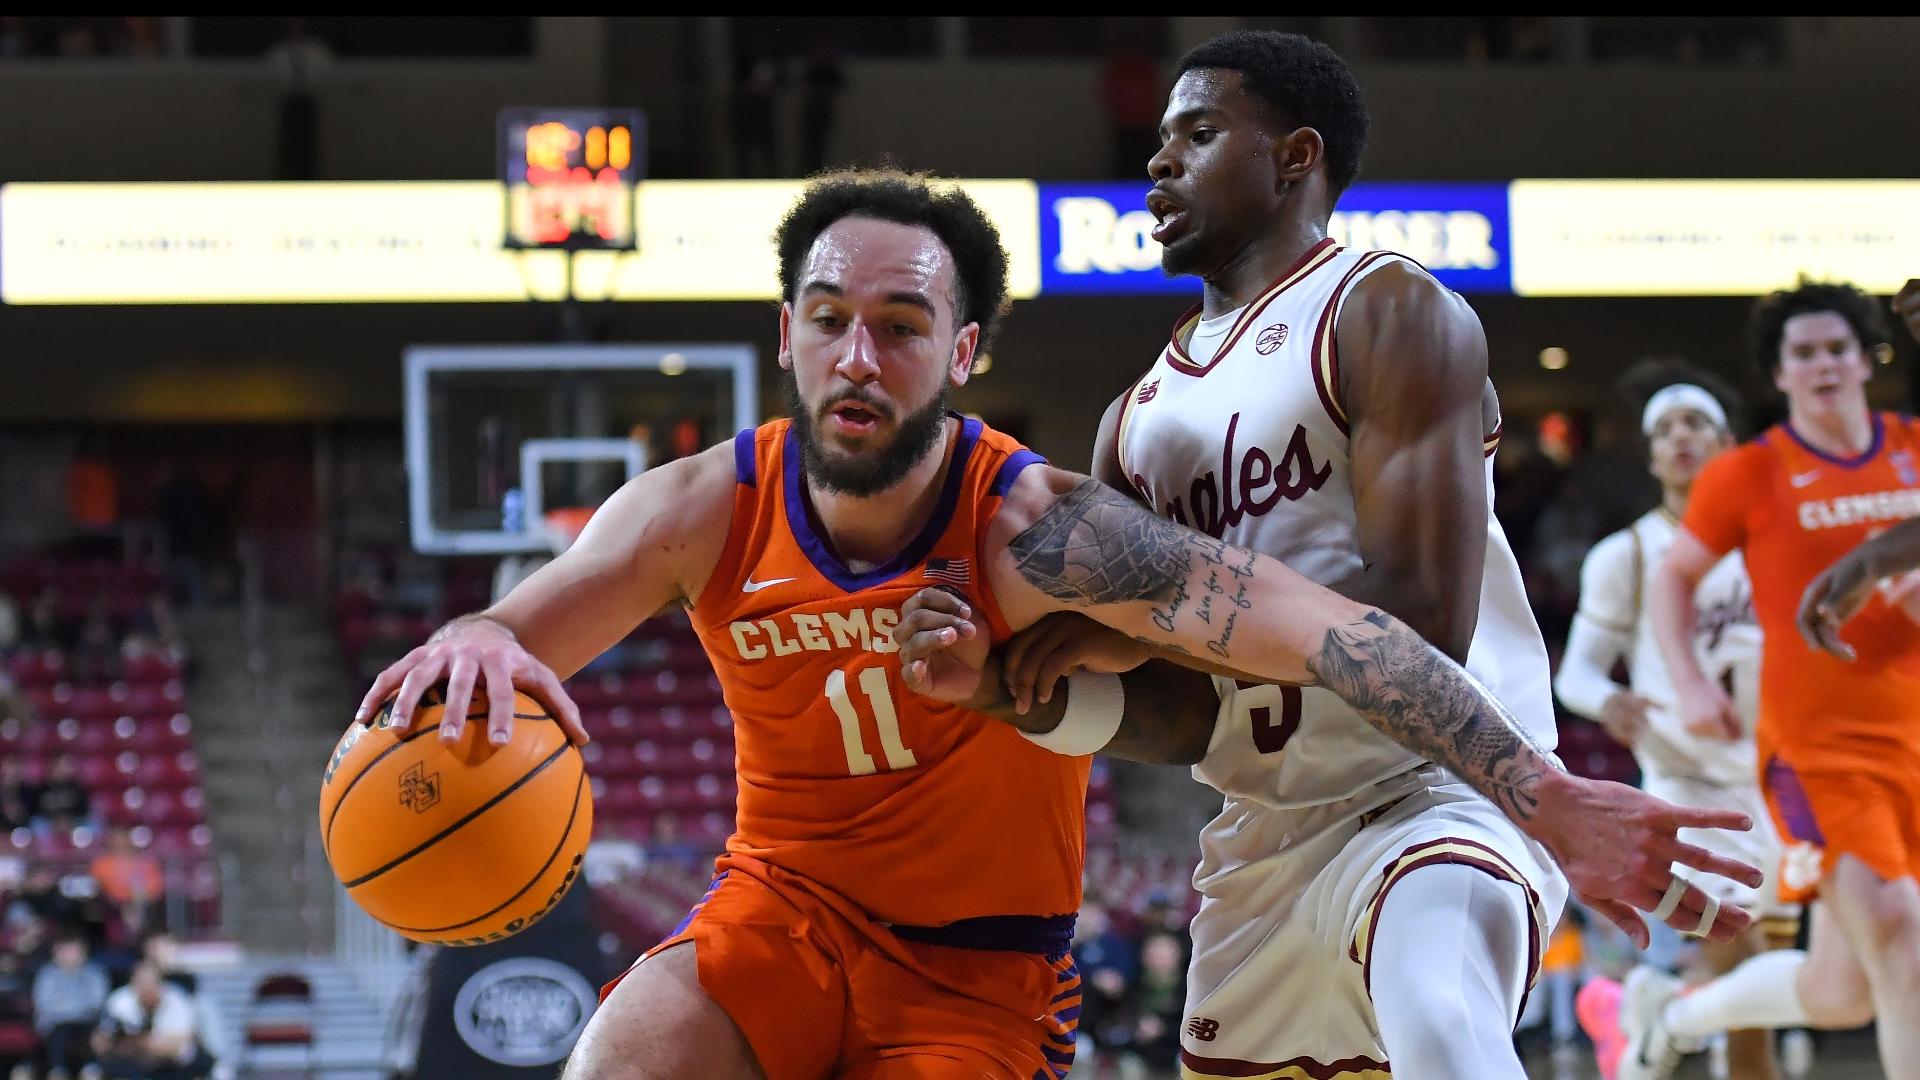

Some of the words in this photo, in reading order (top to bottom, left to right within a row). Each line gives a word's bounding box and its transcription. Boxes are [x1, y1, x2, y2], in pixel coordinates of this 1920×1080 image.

[1203, 568, 1223, 594] for
[729, 607, 902, 660] CLEMS
[1207, 609, 1236, 659] Dream
[1229, 582, 1251, 608] for
[824, 666, 919, 776] 11
